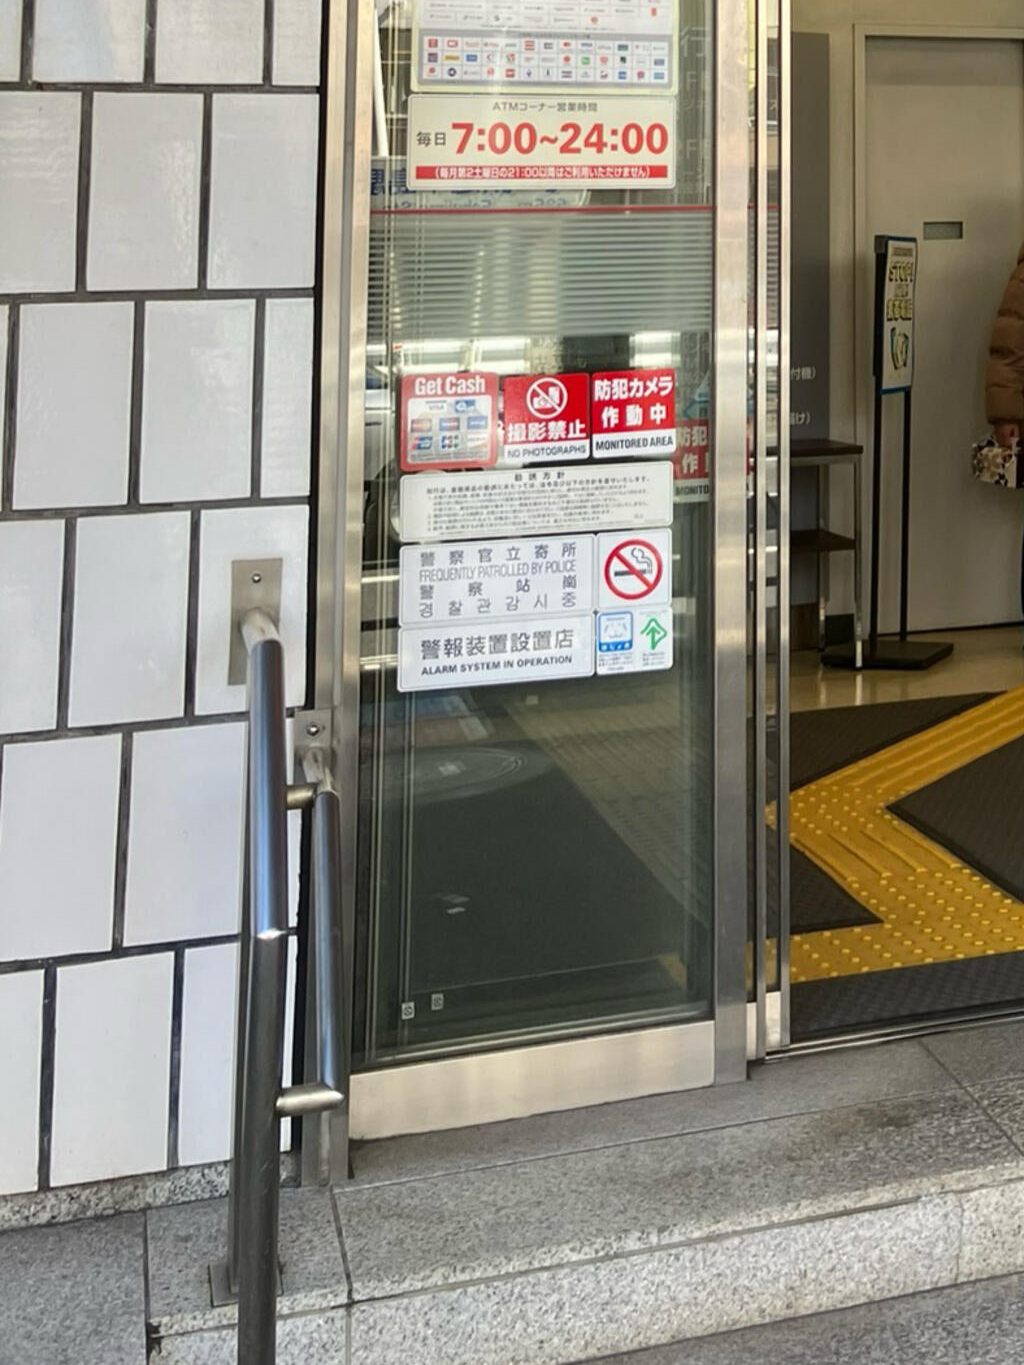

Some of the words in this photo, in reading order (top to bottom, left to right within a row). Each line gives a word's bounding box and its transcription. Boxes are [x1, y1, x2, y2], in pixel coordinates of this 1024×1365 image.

[492, 101, 598, 113] ATMコーナー営業時間
[416, 130, 446, 147] 毎日
[414, 377, 443, 395] Get
[445, 375, 486, 394] Cash
[594, 376, 673, 402] 防犯カメラ
[601, 403, 667, 428] 作動中
[507, 419, 587, 443] 撮影禁止
[507, 449, 520, 458] NO
[522, 444, 587, 457] PHOTOGRAPHS
[595, 439, 648, 451] MONITORED
[649, 435, 673, 447] AREA
[420, 541, 577, 568] 警察官立寄所
[419, 566, 475, 583] FREQUENTLY
[477, 563, 530, 579] PATROLLED
[531, 563, 544, 575] BY
[545, 559, 576, 574] POLICE
[421, 629, 574, 661] 警報装置設置店
[421, 664, 457, 676] ALARM
[460, 661, 500, 673] SYSTEM
[503, 659, 514, 669] IN
[517, 655, 573, 668] OPERATION
